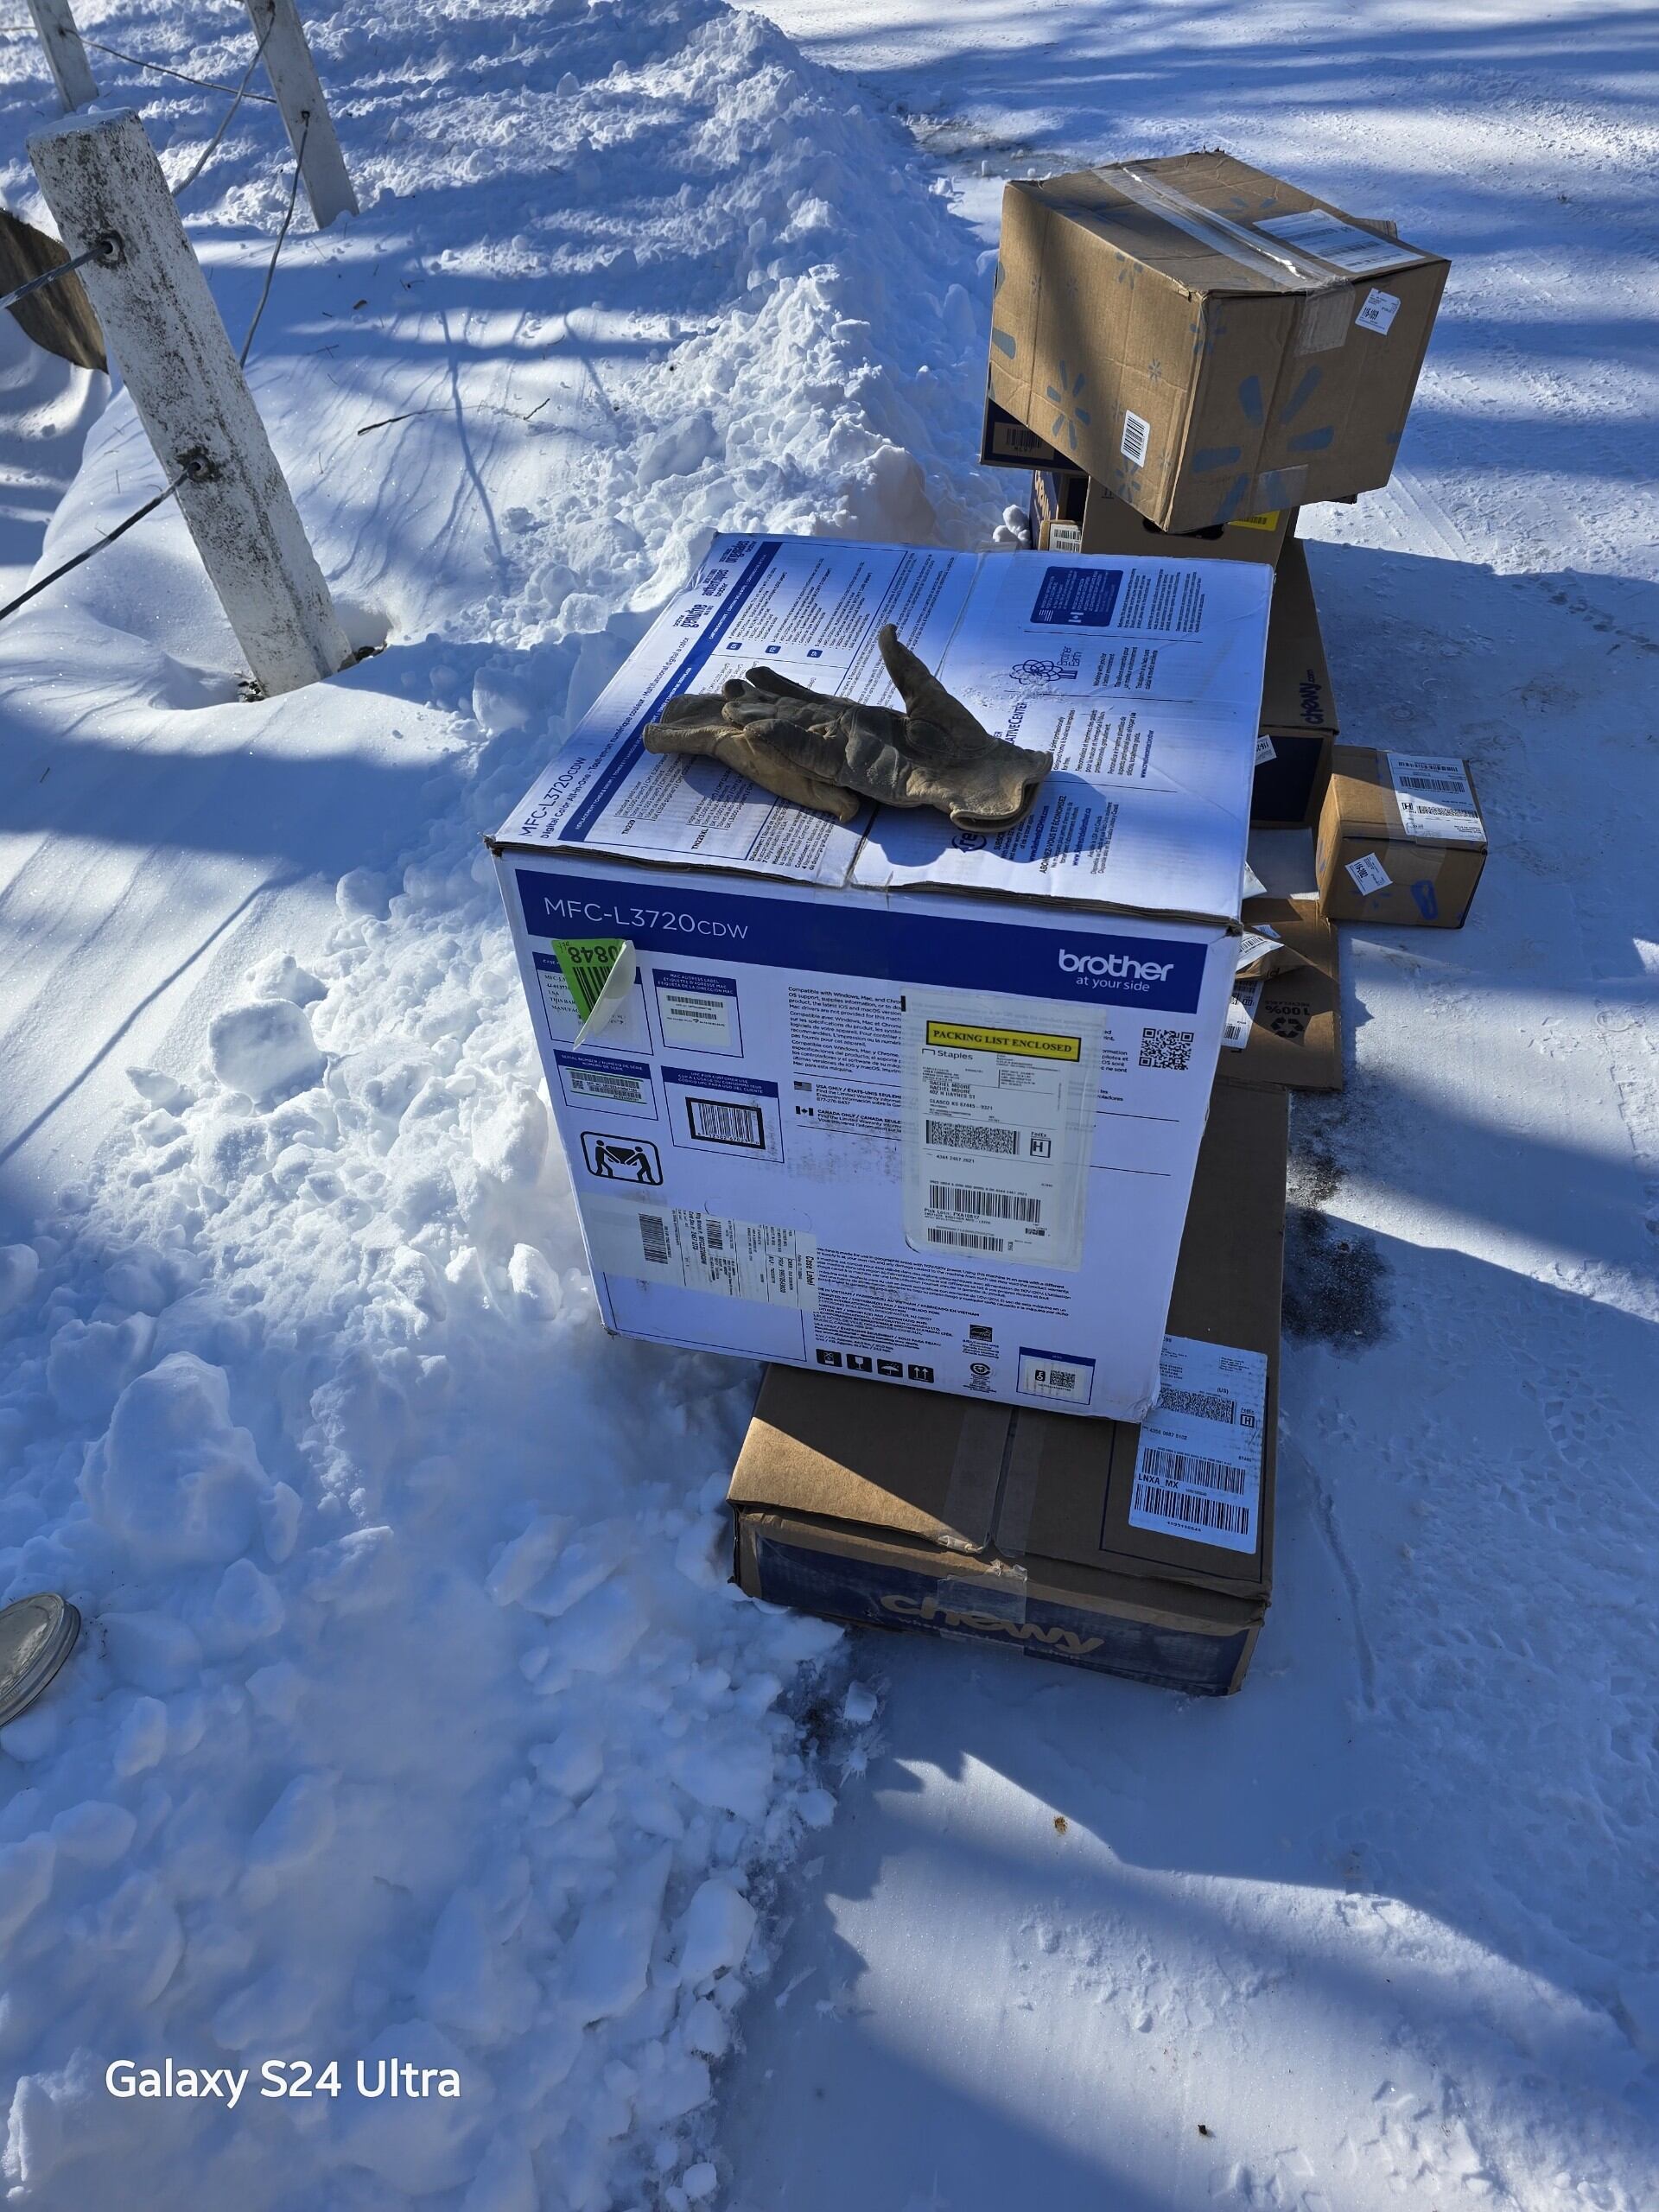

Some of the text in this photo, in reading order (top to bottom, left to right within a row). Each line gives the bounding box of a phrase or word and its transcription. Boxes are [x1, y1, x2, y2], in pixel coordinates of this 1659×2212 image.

[1056, 645, 1072, 665] Brother
[1067, 651, 1083, 666] Earth
[539, 817, 562, 838] Digital
[554, 802, 573, 817] Color
[608, 716, 633, 742] numérique
[626, 699, 646, 716] couleur
[516, 756, 588, 836] MFC-L3720CDW
[620, 819, 636, 834] TN229
[690, 828, 709, 849] TN229XL
[543, 897, 748, 940] MFC-L3720CDW
[1058, 949, 1173, 982] brother
[788, 986, 819, 995] Compatible
[1077, 977, 1150, 992] at your side
[1265, 1006, 1310, 1015] 100%
[933, 1030, 1072, 1053] PACKING LIST ENCLOSED
[938, 1049, 974, 1061] Staples
[1033, 1141, 1043, 1152] H
[804, 1255, 815, 1286] Case Label
[880, 1595, 1104, 1655] chewy
